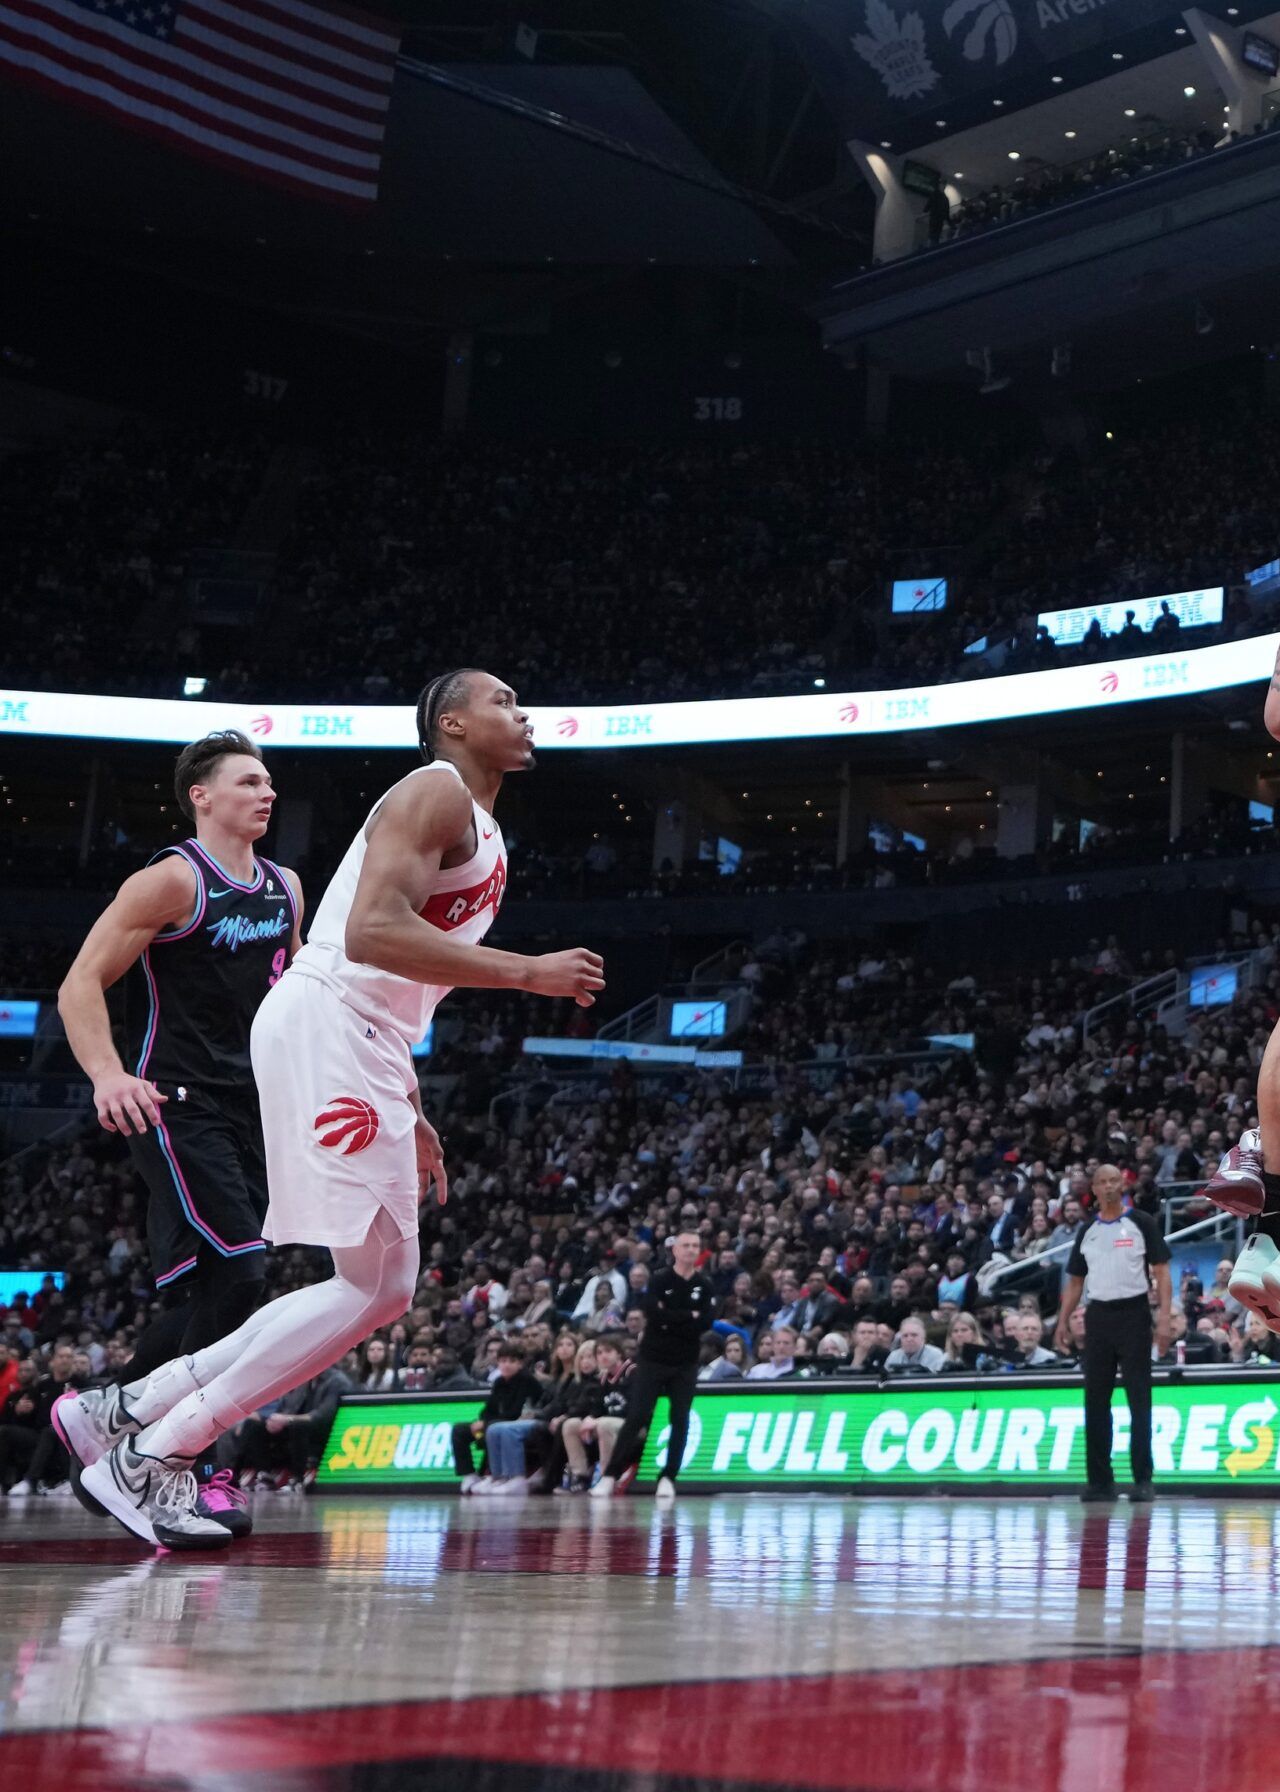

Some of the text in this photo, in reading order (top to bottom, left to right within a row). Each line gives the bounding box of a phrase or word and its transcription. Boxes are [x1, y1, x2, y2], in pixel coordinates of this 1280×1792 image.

[243, 369, 288, 401] 317
[693, 396, 743, 421] 318
[1143, 660, 1189, 688] IBM
[885, 696, 929, 720] IBM
[302, 714, 353, 736] IBM
[605, 715, 652, 736] IBM
[446, 870, 504, 923] RAPT
[206, 908, 289, 953] Miami
[268, 947, 287, 987] 9
[329, 1421, 457, 1473] SUBWA
[711, 1411, 849, 1472] FULL
[861, 1408, 1085, 1473] COURT
